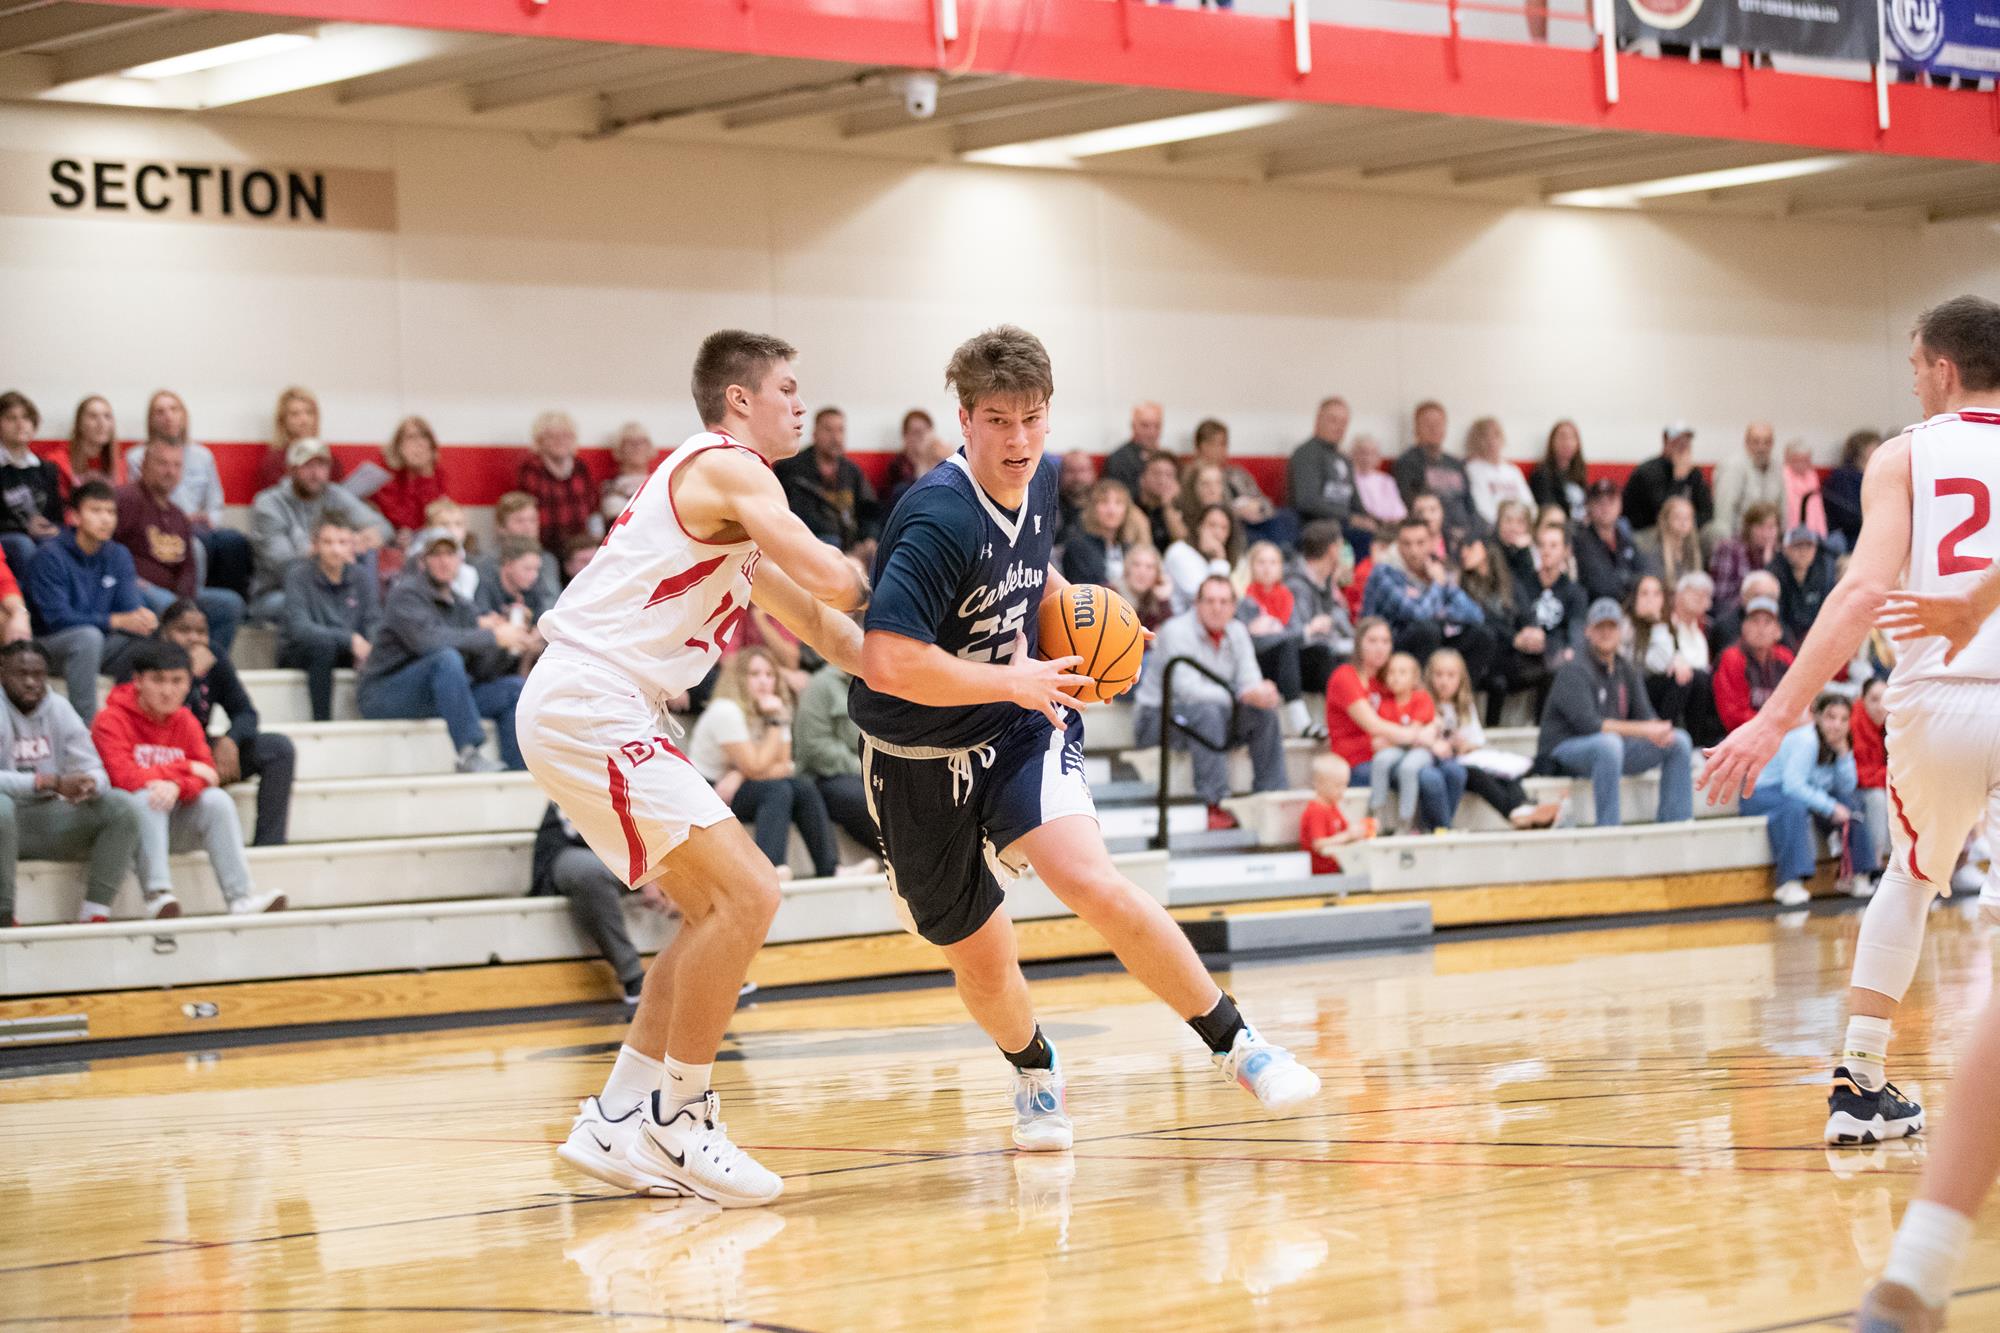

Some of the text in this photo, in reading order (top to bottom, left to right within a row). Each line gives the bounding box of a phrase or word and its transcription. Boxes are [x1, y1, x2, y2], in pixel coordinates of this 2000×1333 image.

[50, 159, 326, 221] SECTION
[1934, 477, 1994, 576] 2
[958, 560, 1043, 618] Carleton
[1072, 585, 1096, 630] Wils
